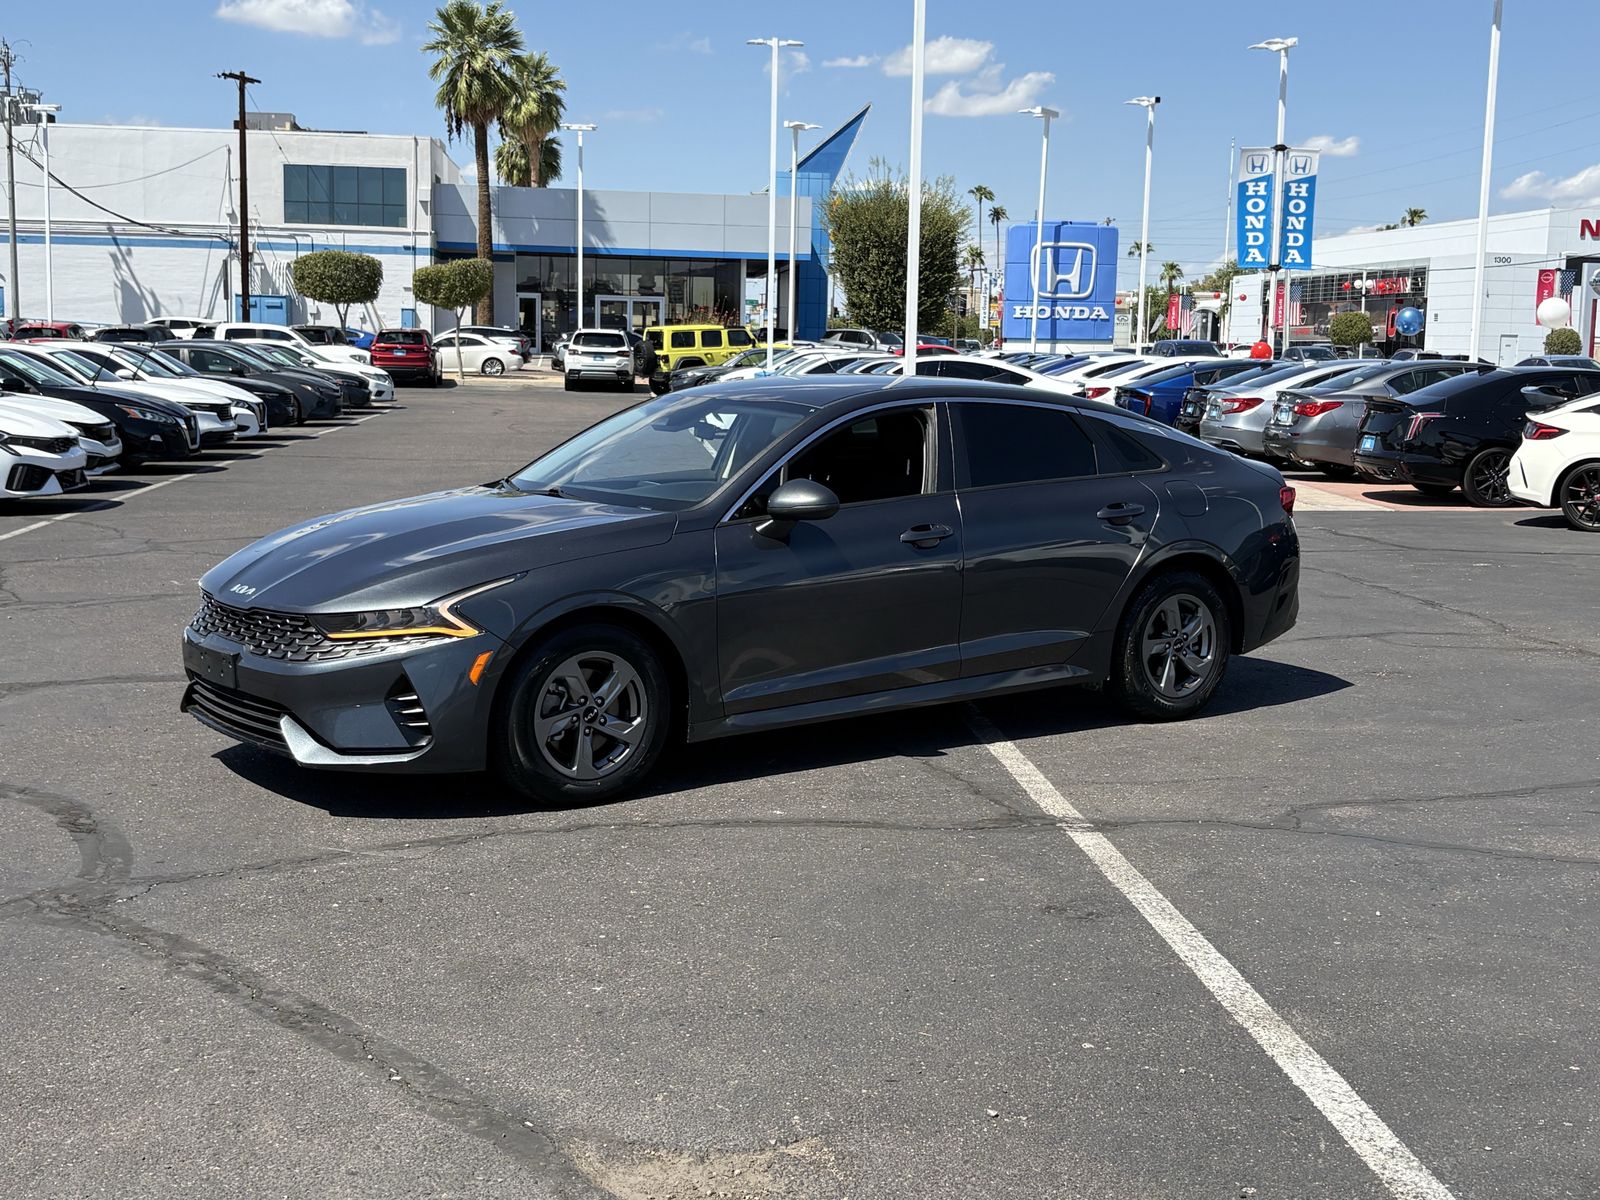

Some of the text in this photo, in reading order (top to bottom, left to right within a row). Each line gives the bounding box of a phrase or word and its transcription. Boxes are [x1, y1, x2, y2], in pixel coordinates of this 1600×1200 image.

[1245, 182, 1267, 262] HONDA
[1285, 183, 1309, 263] HONDA
[1494, 256, 1512, 264] 1300
[1012, 305, 1109, 319] HONDA
